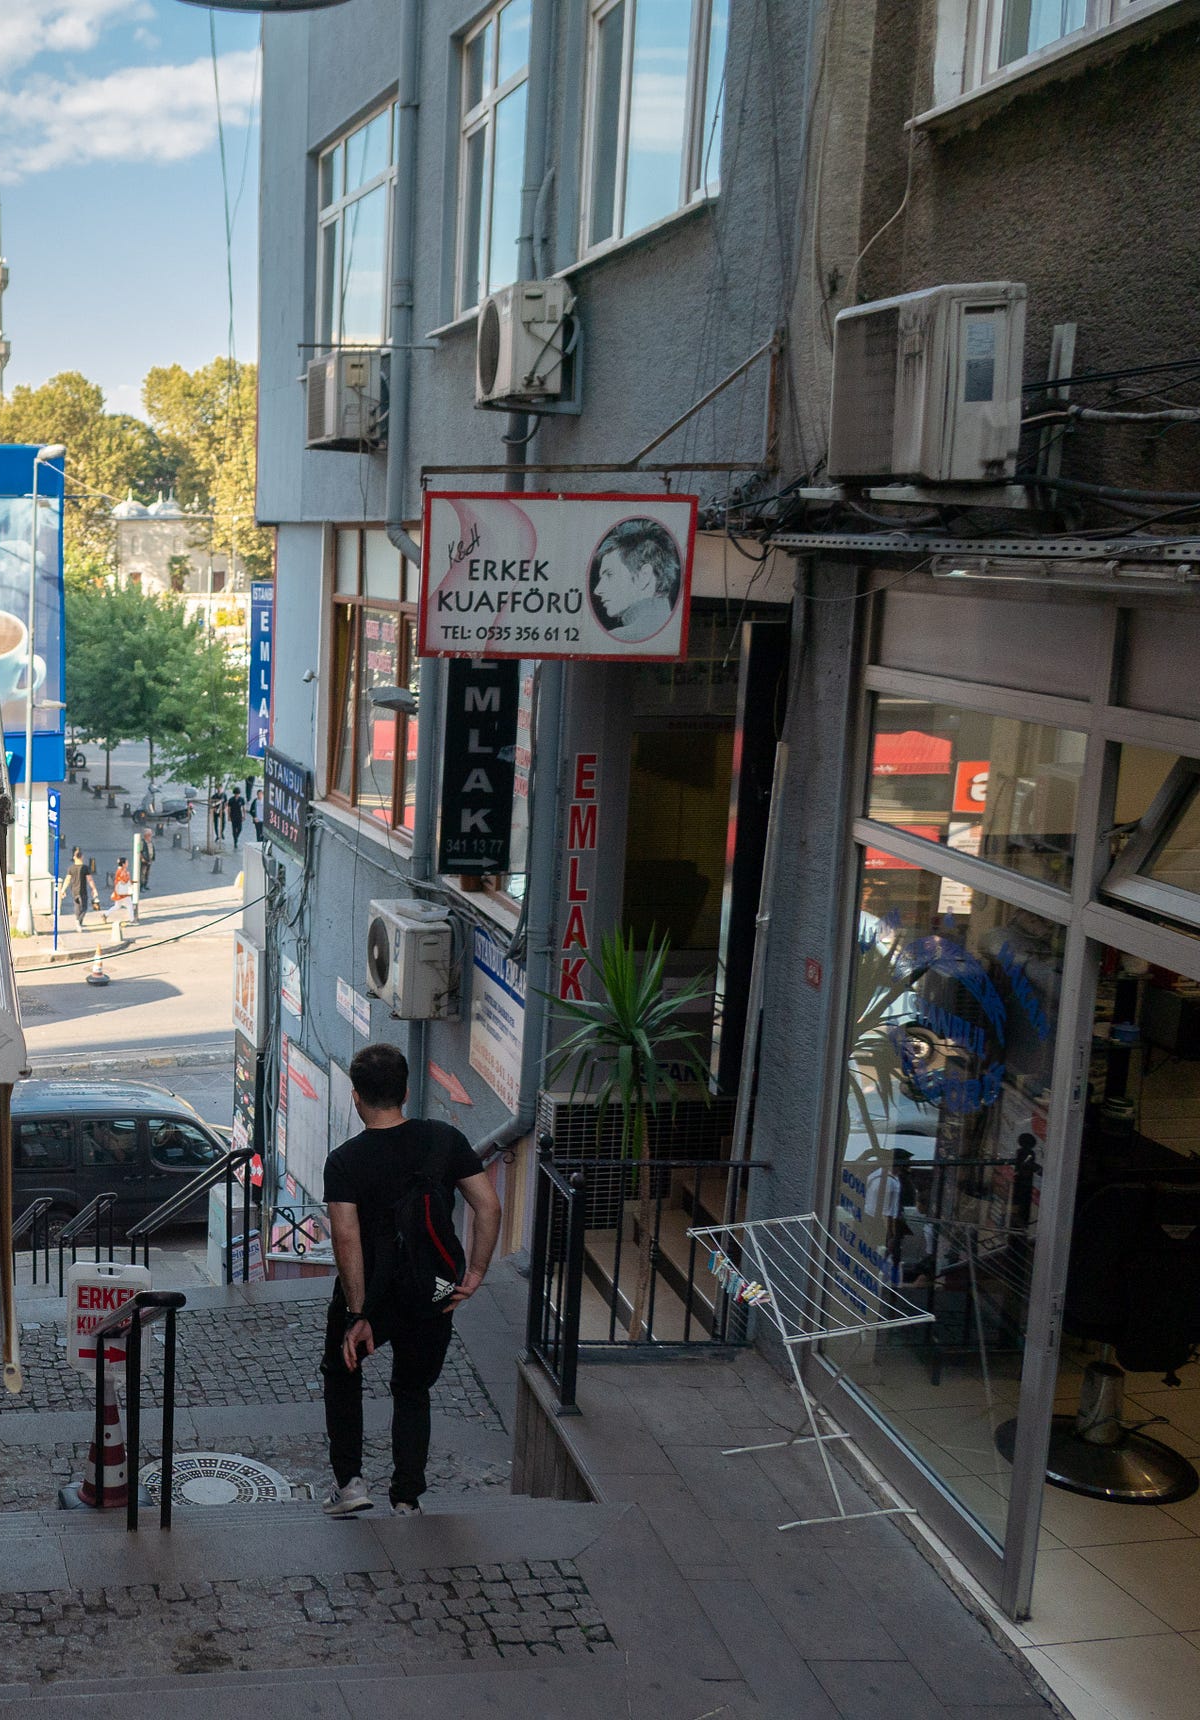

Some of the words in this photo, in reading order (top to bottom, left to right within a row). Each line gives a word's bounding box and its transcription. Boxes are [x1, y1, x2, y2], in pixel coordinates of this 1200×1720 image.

[467, 559, 550, 582] ERKEK
[437, 587, 583, 614] KUAFFÖRÜ
[440, 625, 472, 641] TEL:
[476, 626, 512, 641] 0535
[516, 626, 540, 641] 356
[544, 626, 559, 642] 61
[564, 627, 580, 642] 12
[258, 611, 270, 748] EMLAK
[268, 782, 301, 826] EMLAK
[269, 810, 280, 830] 341
[281, 820, 289, 837] 13
[289, 825, 298, 843] 77
[446, 839, 467, 853] 341
[471, 839, 486, 853] 13
[488, 839, 504, 853] 77
[559, 753, 599, 1001] EMLAK
